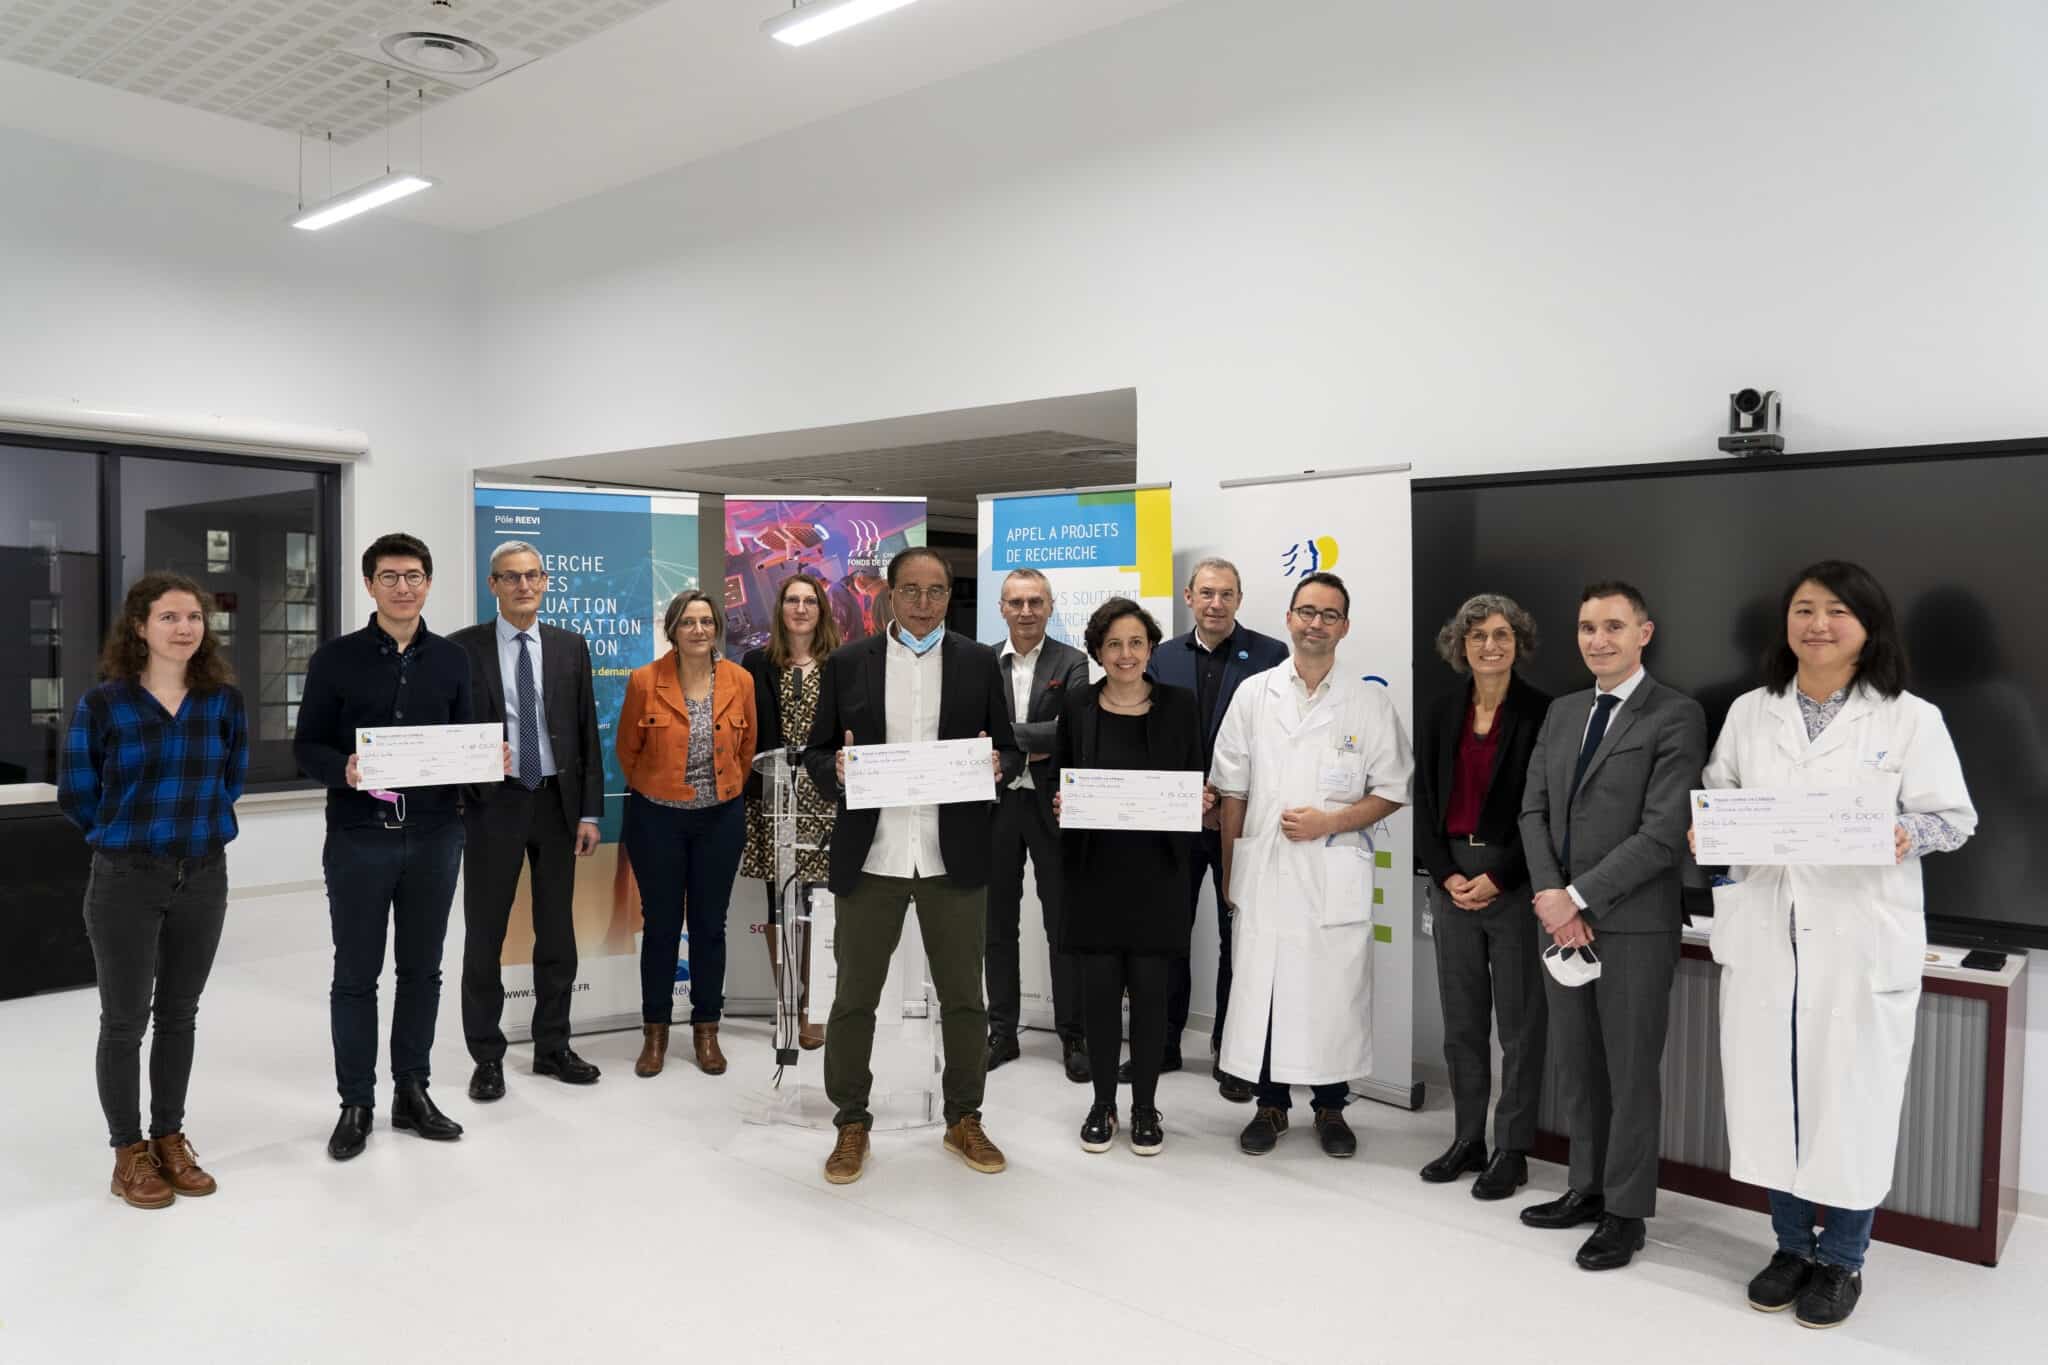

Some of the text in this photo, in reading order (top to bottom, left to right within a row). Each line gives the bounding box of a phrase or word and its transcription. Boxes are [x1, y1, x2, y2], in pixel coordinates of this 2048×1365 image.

[495, 515, 540, 525] Pôle REEVI
[1006, 522, 1119, 542] APPEL A PROJETS
[546, 554, 606, 572] ERCHE
[1006, 545, 1097, 563] DE RECHERCHE
